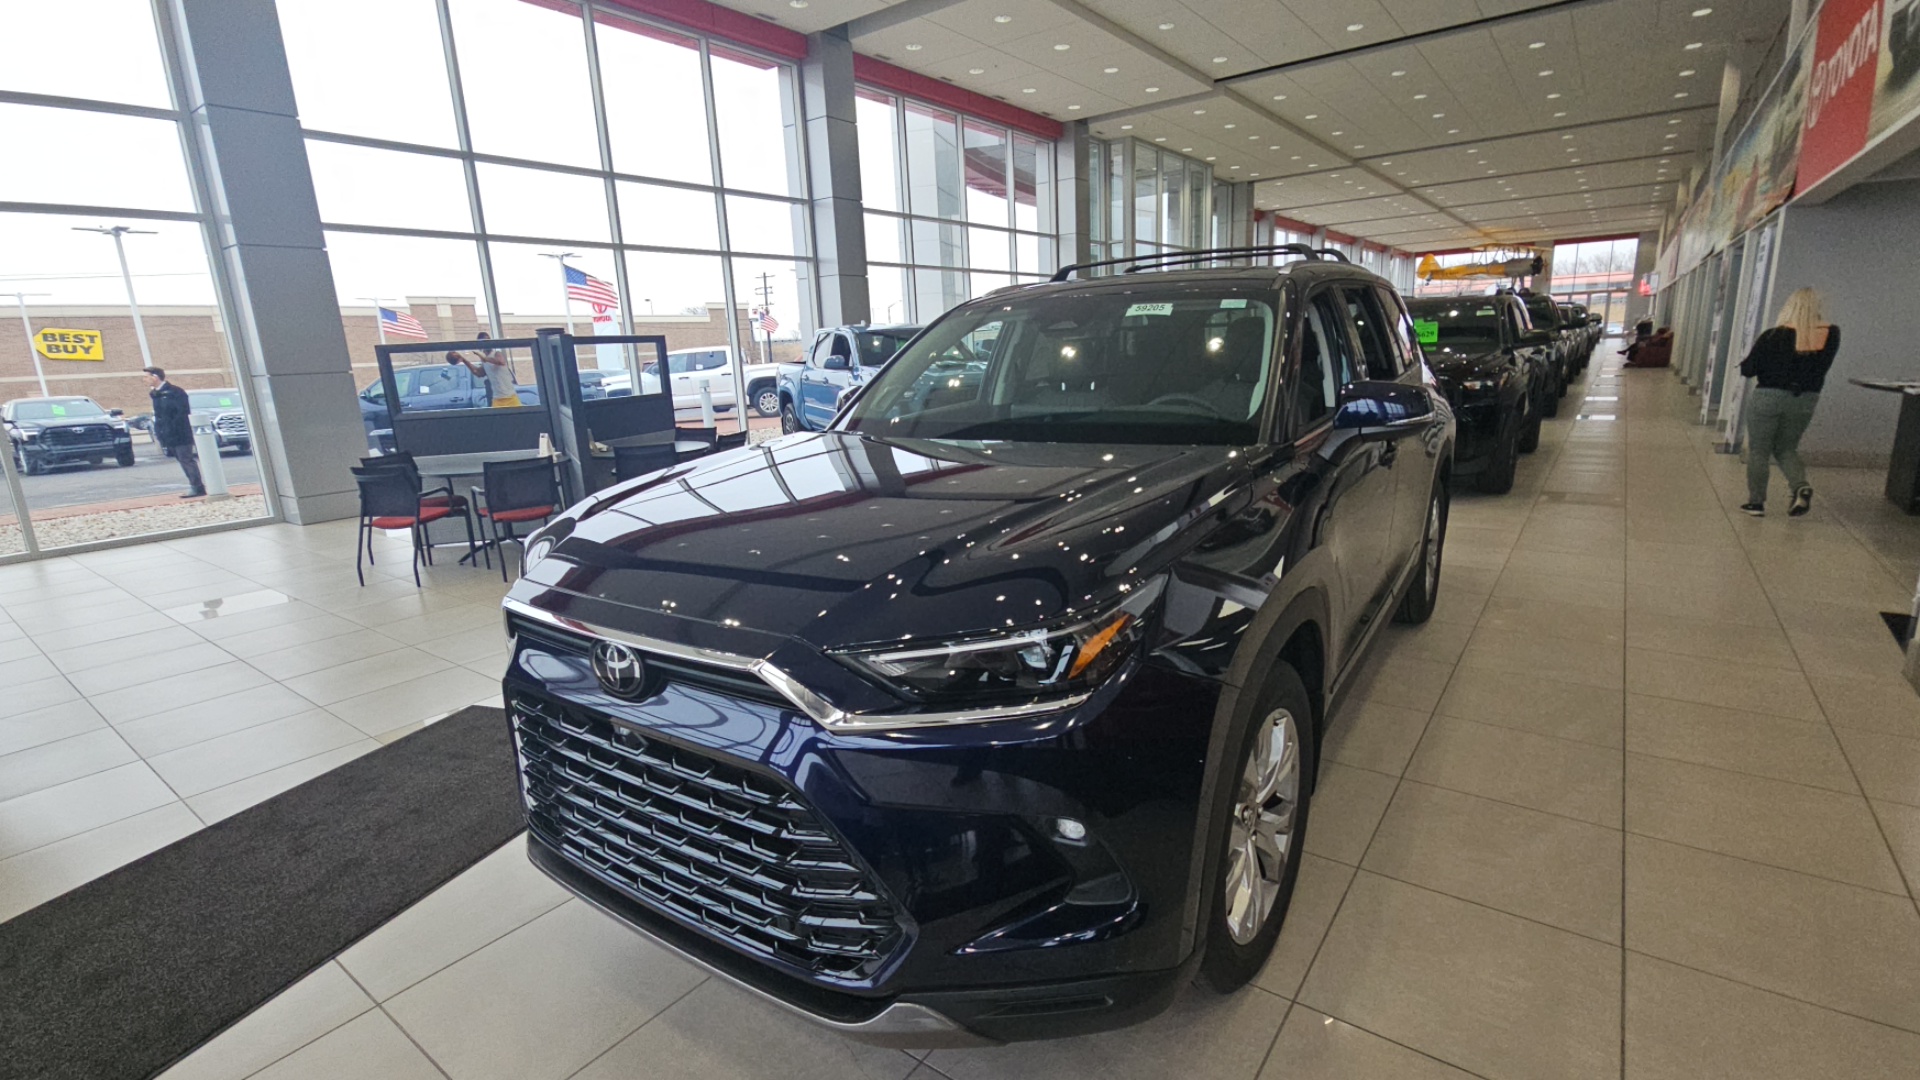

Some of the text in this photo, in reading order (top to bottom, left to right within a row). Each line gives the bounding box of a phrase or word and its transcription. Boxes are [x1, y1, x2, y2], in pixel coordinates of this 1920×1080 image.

[1822, 0, 1879, 104] TOYOTA
[1135, 304, 1165, 312] 59205
[42, 333, 98, 343] BEST
[46, 344, 94, 354] BUY
